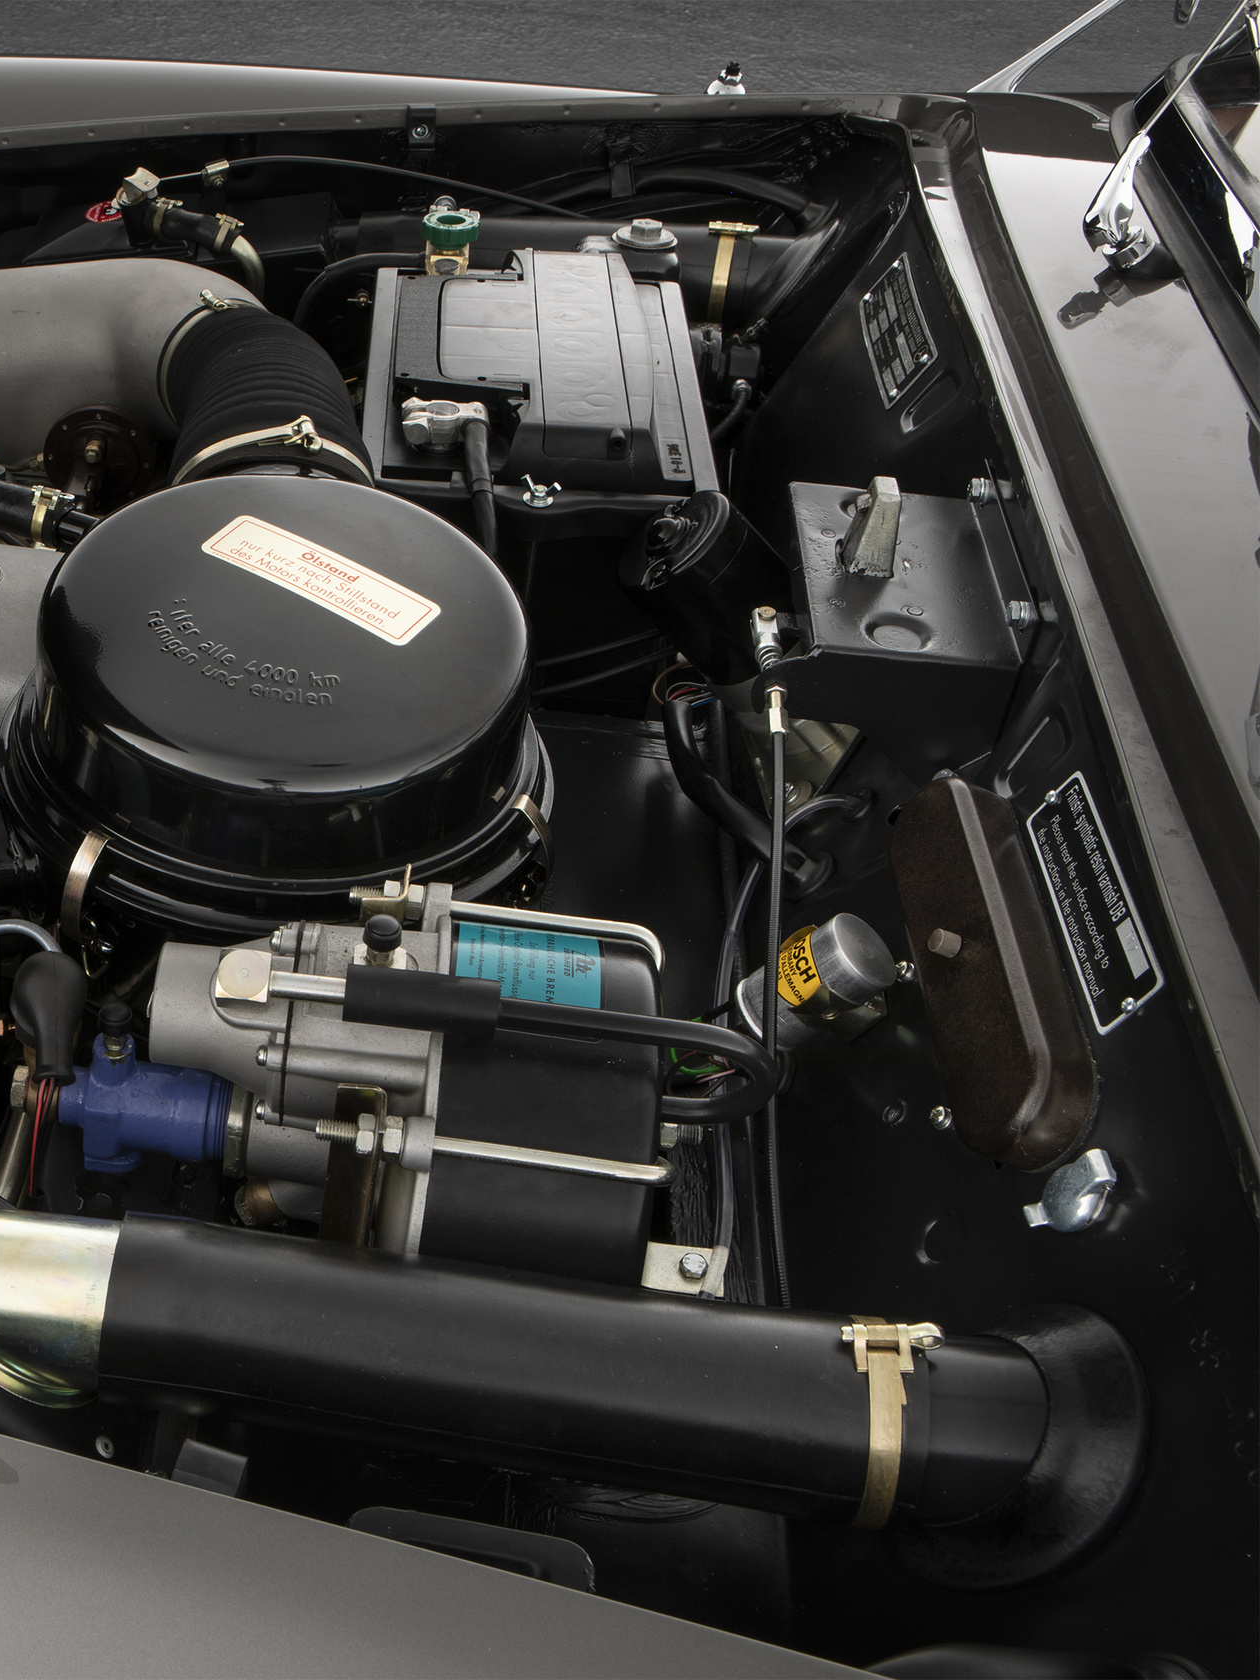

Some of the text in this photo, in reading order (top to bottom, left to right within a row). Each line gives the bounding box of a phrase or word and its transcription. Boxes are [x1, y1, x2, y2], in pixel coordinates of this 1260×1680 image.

[229, 547, 253, 561] des
[254, 557, 301, 582] Motors
[302, 578, 385, 628] kontrollieren.
[239, 540, 263, 552] nur
[265, 548, 296, 568] kurz
[298, 565, 332, 585] nach
[335, 582, 401, 619] Stillstand
[301, 550, 360, 583] Ölstand
[147, 609, 199, 665] reinigen
[201, 664, 244, 688] und
[198, 640, 236, 666] alle
[243, 659, 299, 685] 4000
[308, 671, 341, 688] km
[1065, 784, 1085, 819] Finish:
[1074, 814, 1099, 855] synthetic
[1089, 850, 1107, 877] resin
[1050, 814, 1109, 969] Please treat the surface according to
[1098, 871, 1121, 909] varnish
[1109, 900, 1126, 922] DB
[1037, 827, 1105, 1002] the instructions in the instruction manual.
[511, 942, 523, 999] Original-Bremsflüssig
[544, 933, 556, 1004] DRAULISCHE BREM
[793, 938, 817, 984] OSCH
